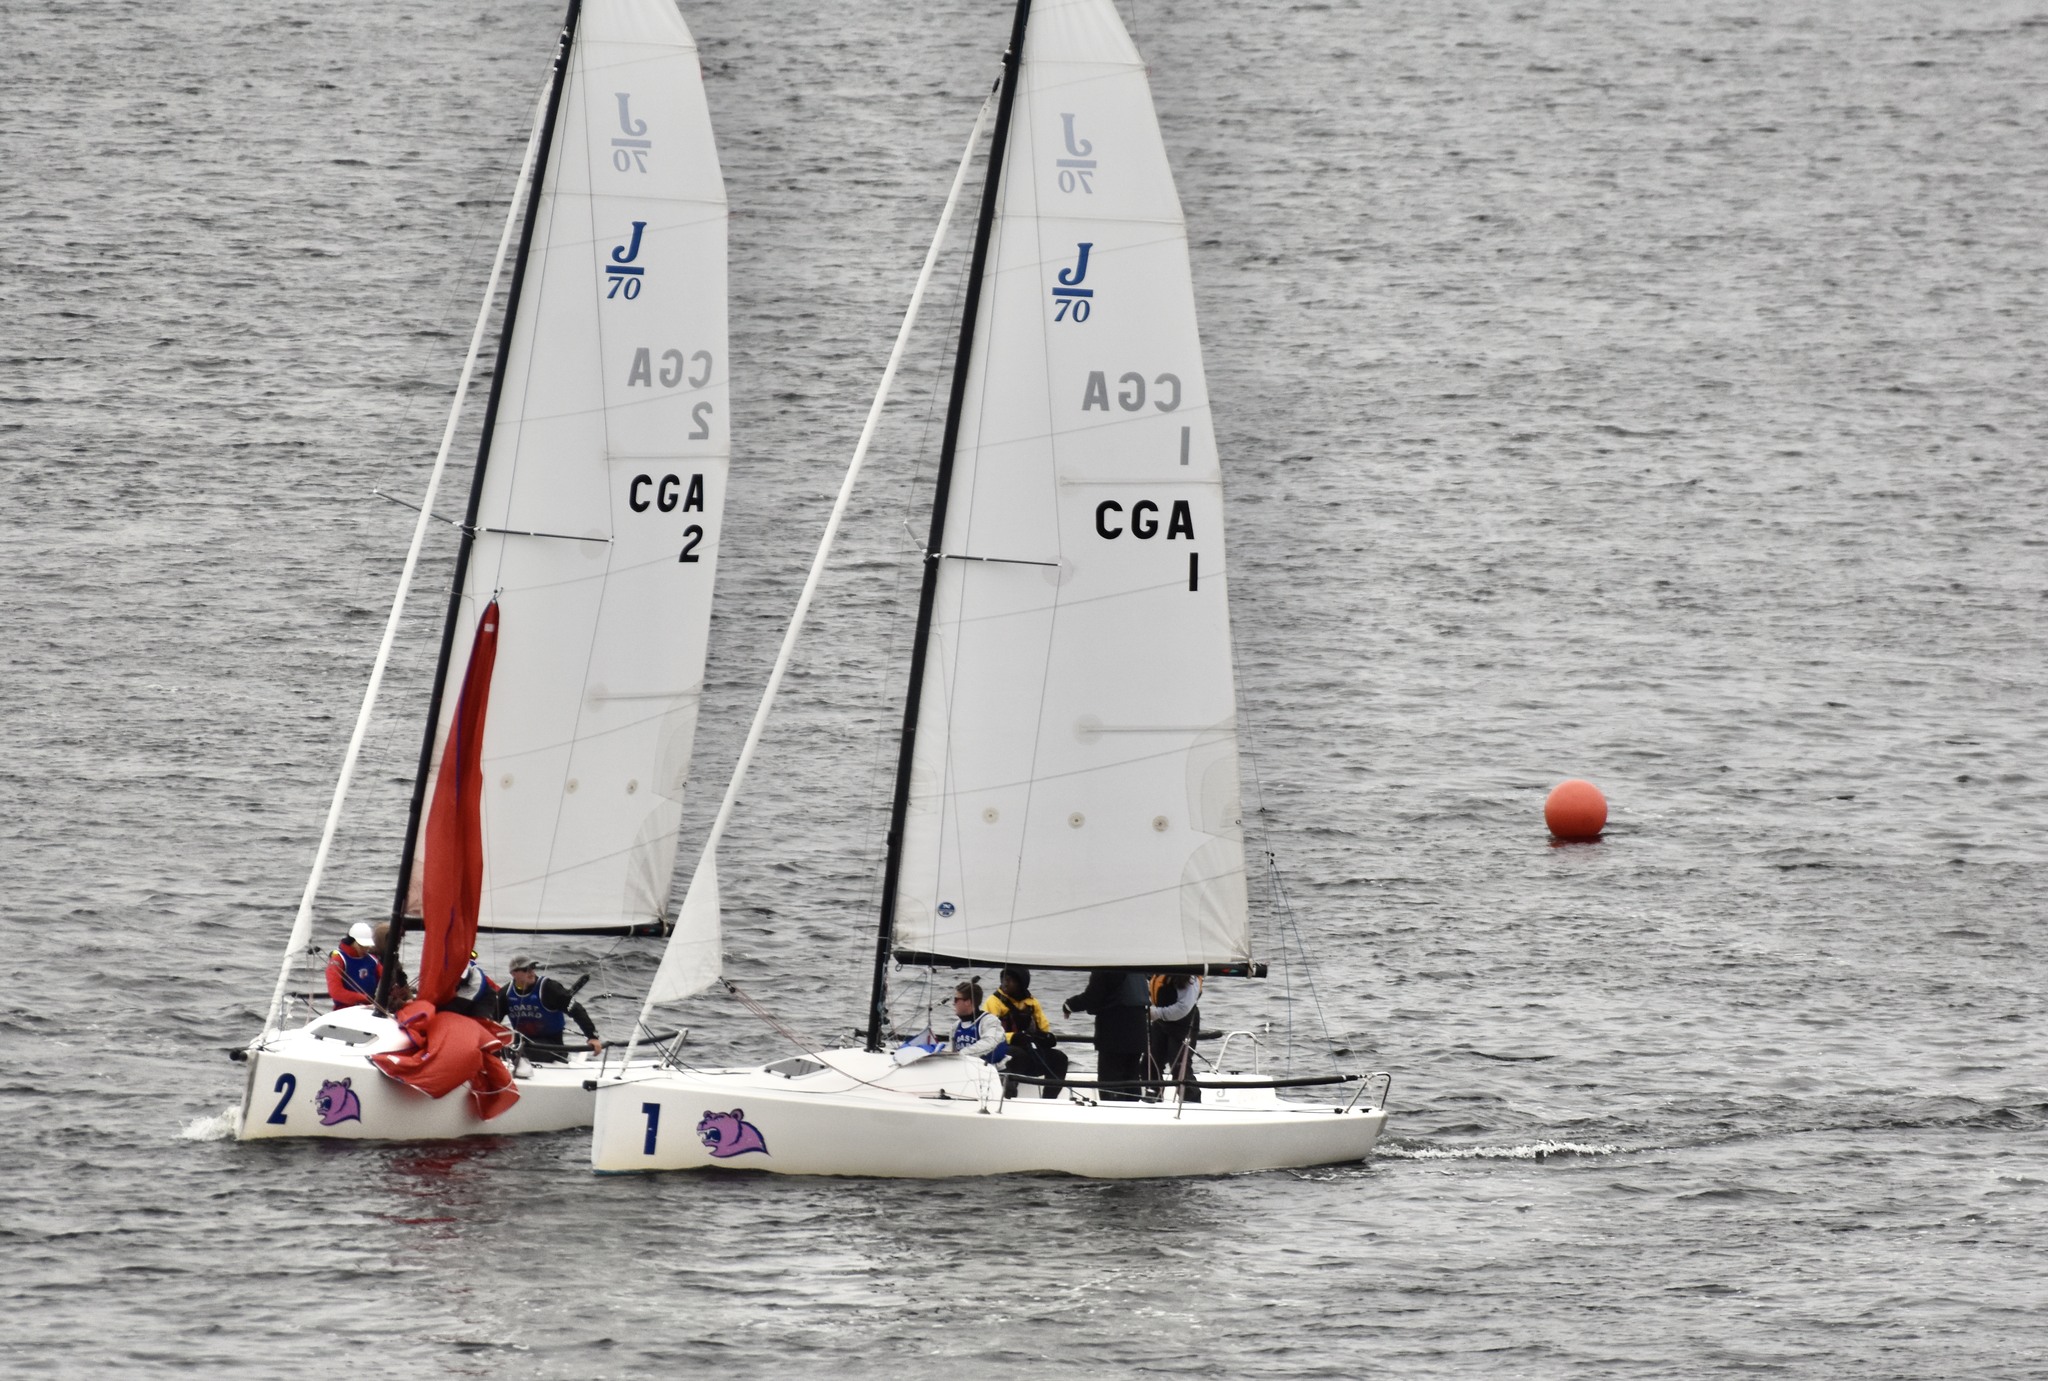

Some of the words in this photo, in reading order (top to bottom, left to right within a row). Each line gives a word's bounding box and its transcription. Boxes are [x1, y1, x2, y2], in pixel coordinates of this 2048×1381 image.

[611, 221, 648, 263] J
[1057, 242, 1094, 286] J
[606, 275, 641, 300] 70
[1053, 298, 1091, 323] 70
[629, 473, 704, 513] CGA
[1095, 499, 1195, 540] CGA
[678, 524, 704, 563] 2
[266, 1073, 296, 1125] 2
[641, 1102, 661, 1155] 1
